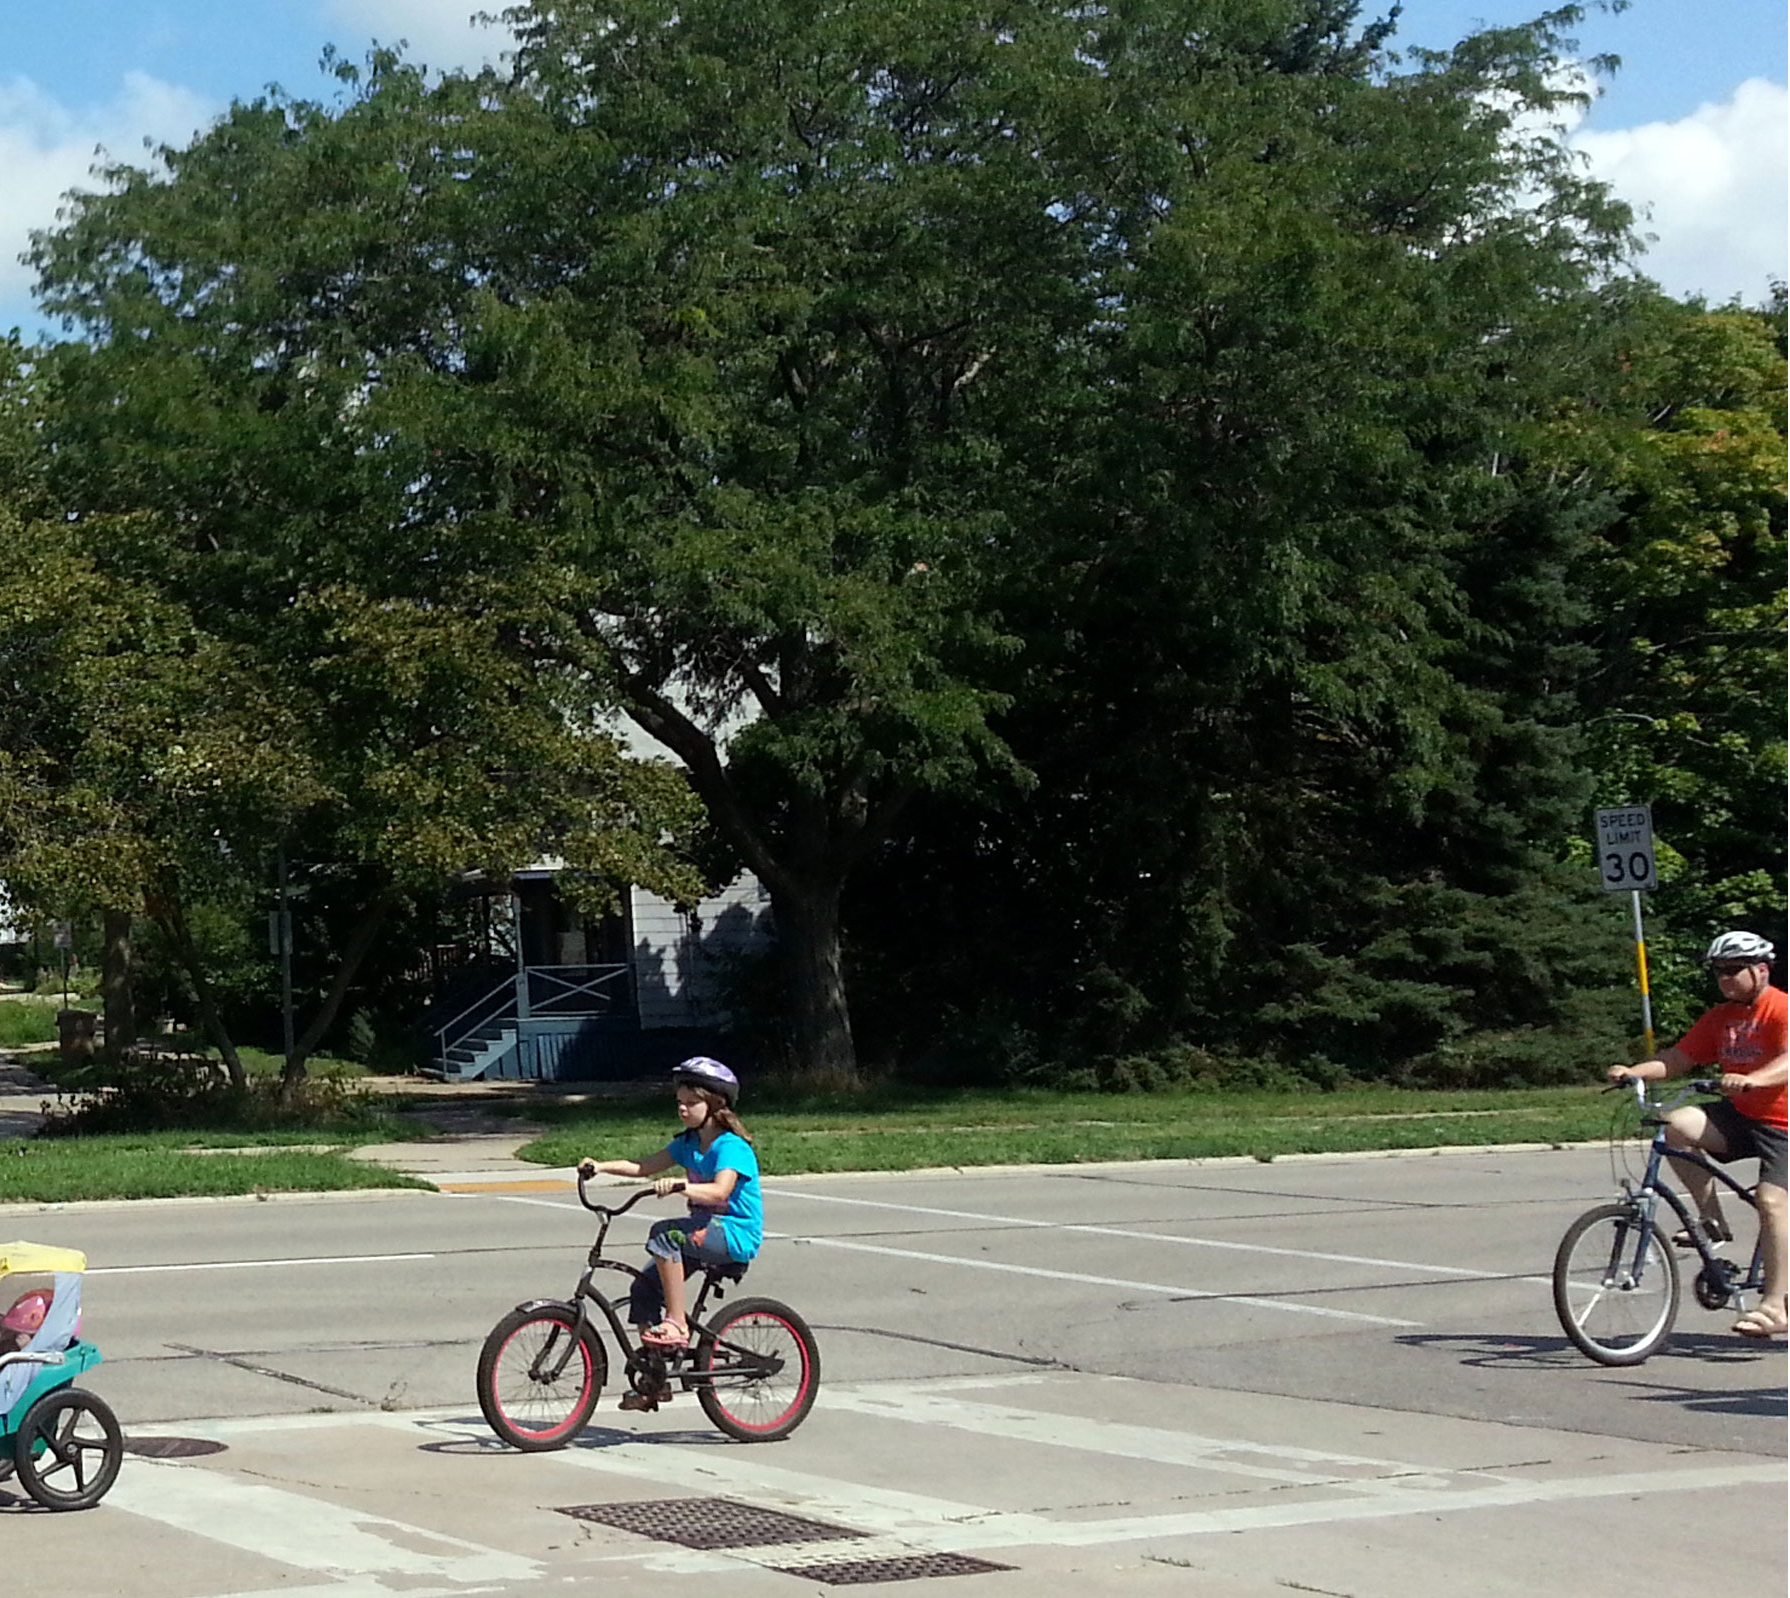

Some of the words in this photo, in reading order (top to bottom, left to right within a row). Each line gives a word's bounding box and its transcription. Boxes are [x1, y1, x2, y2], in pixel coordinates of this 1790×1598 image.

[1600, 813, 1646, 828] SPEED
[1607, 830, 1641, 845] LIMIT
[1606, 852, 1649, 882] 30
